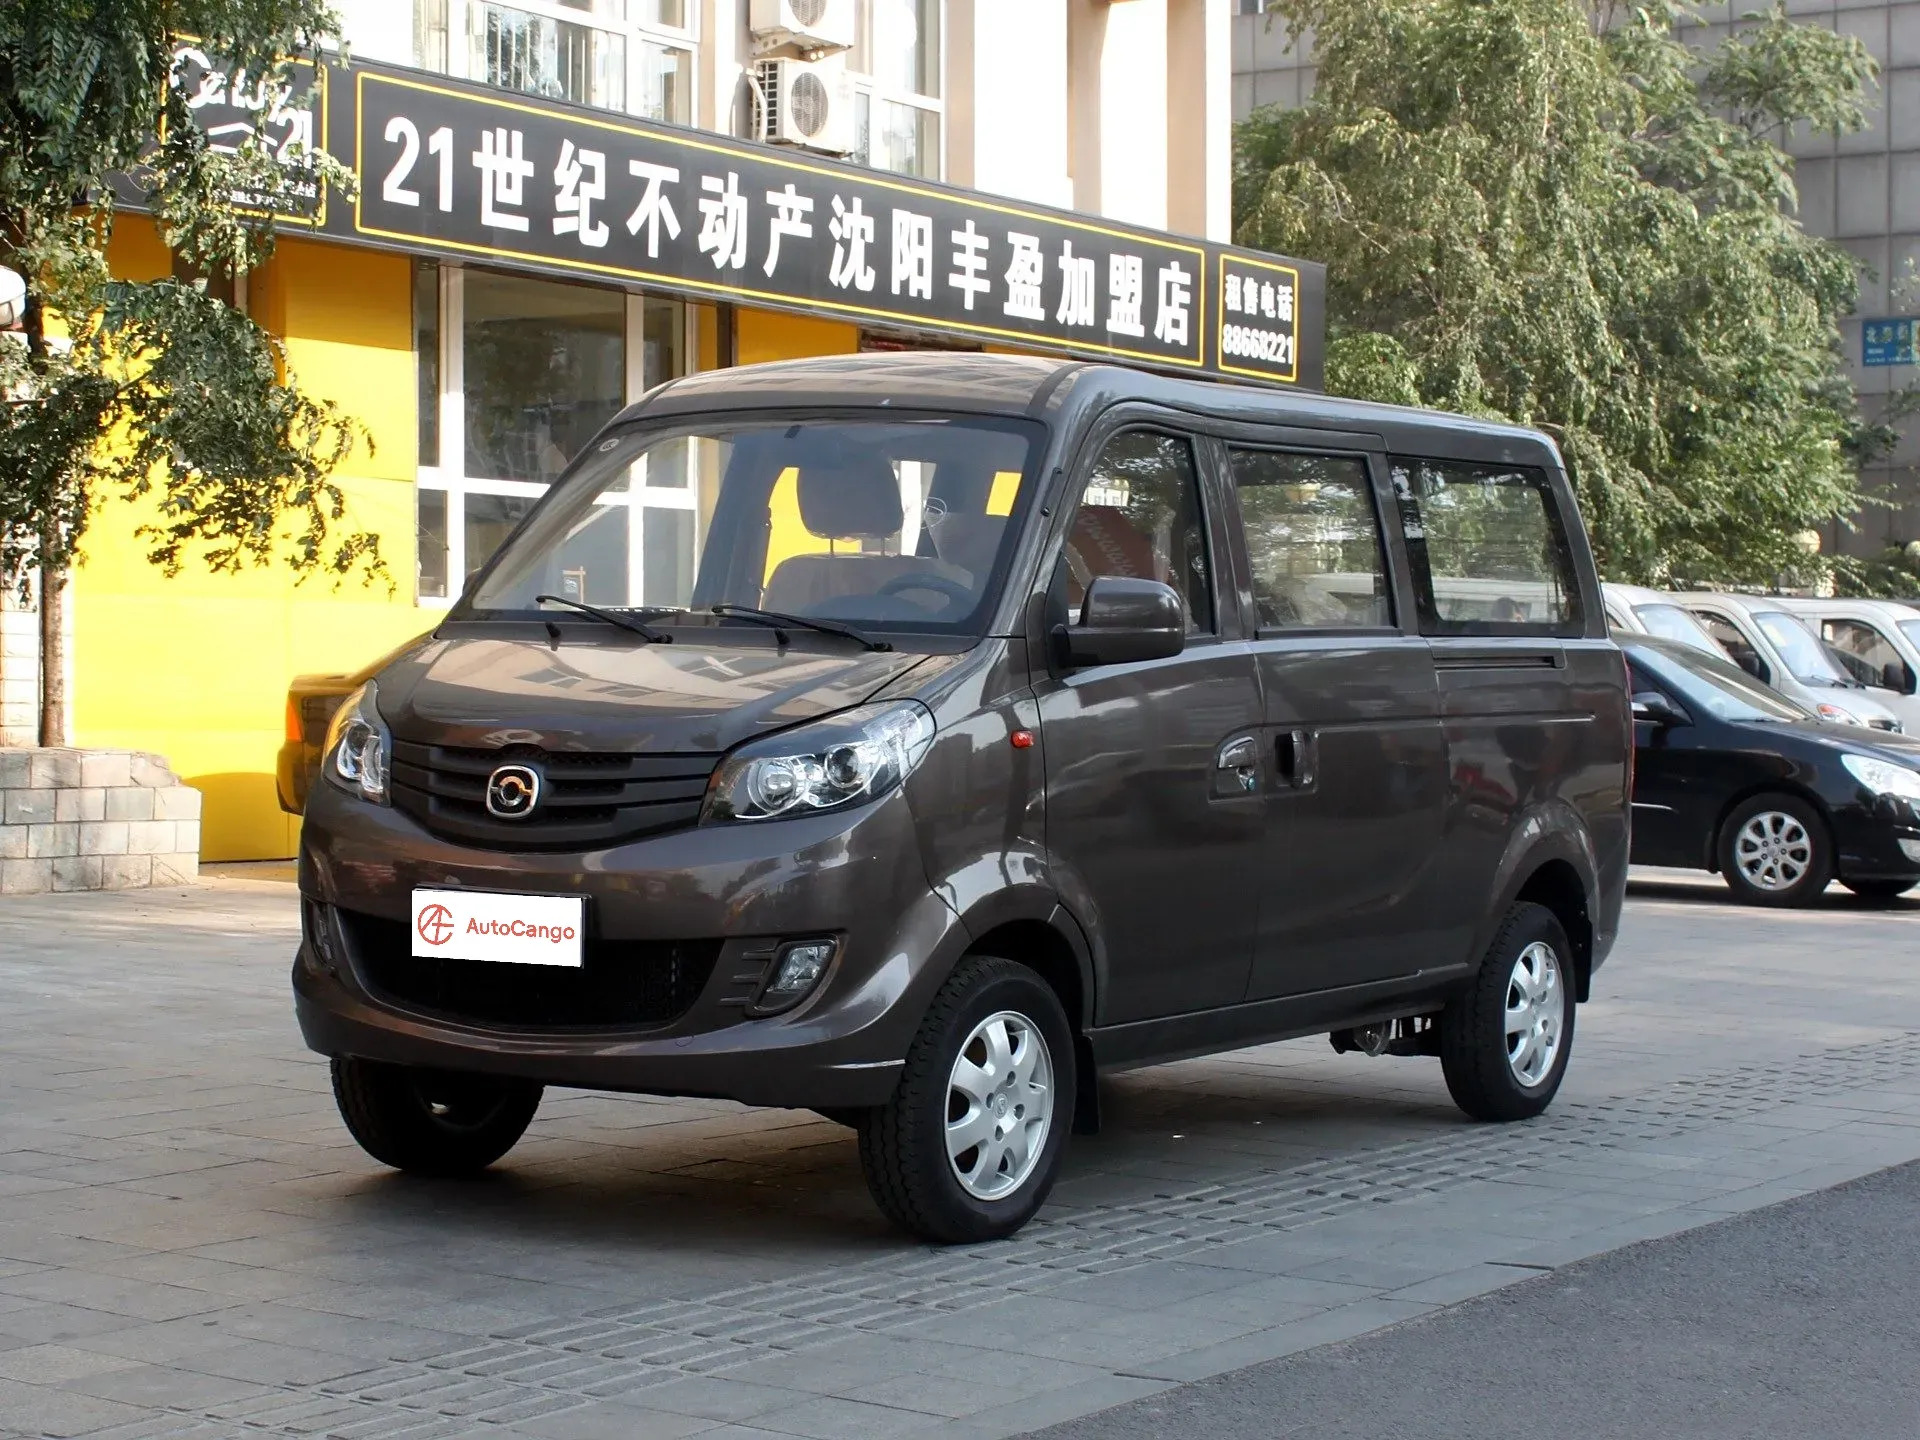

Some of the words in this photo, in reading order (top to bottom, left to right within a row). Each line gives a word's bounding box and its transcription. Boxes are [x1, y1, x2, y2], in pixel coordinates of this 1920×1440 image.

[382, 116, 1192, 346] 21世纪不动产沈阳丰盈加盟店
[1222, 323, 1294, 364] 88668221
